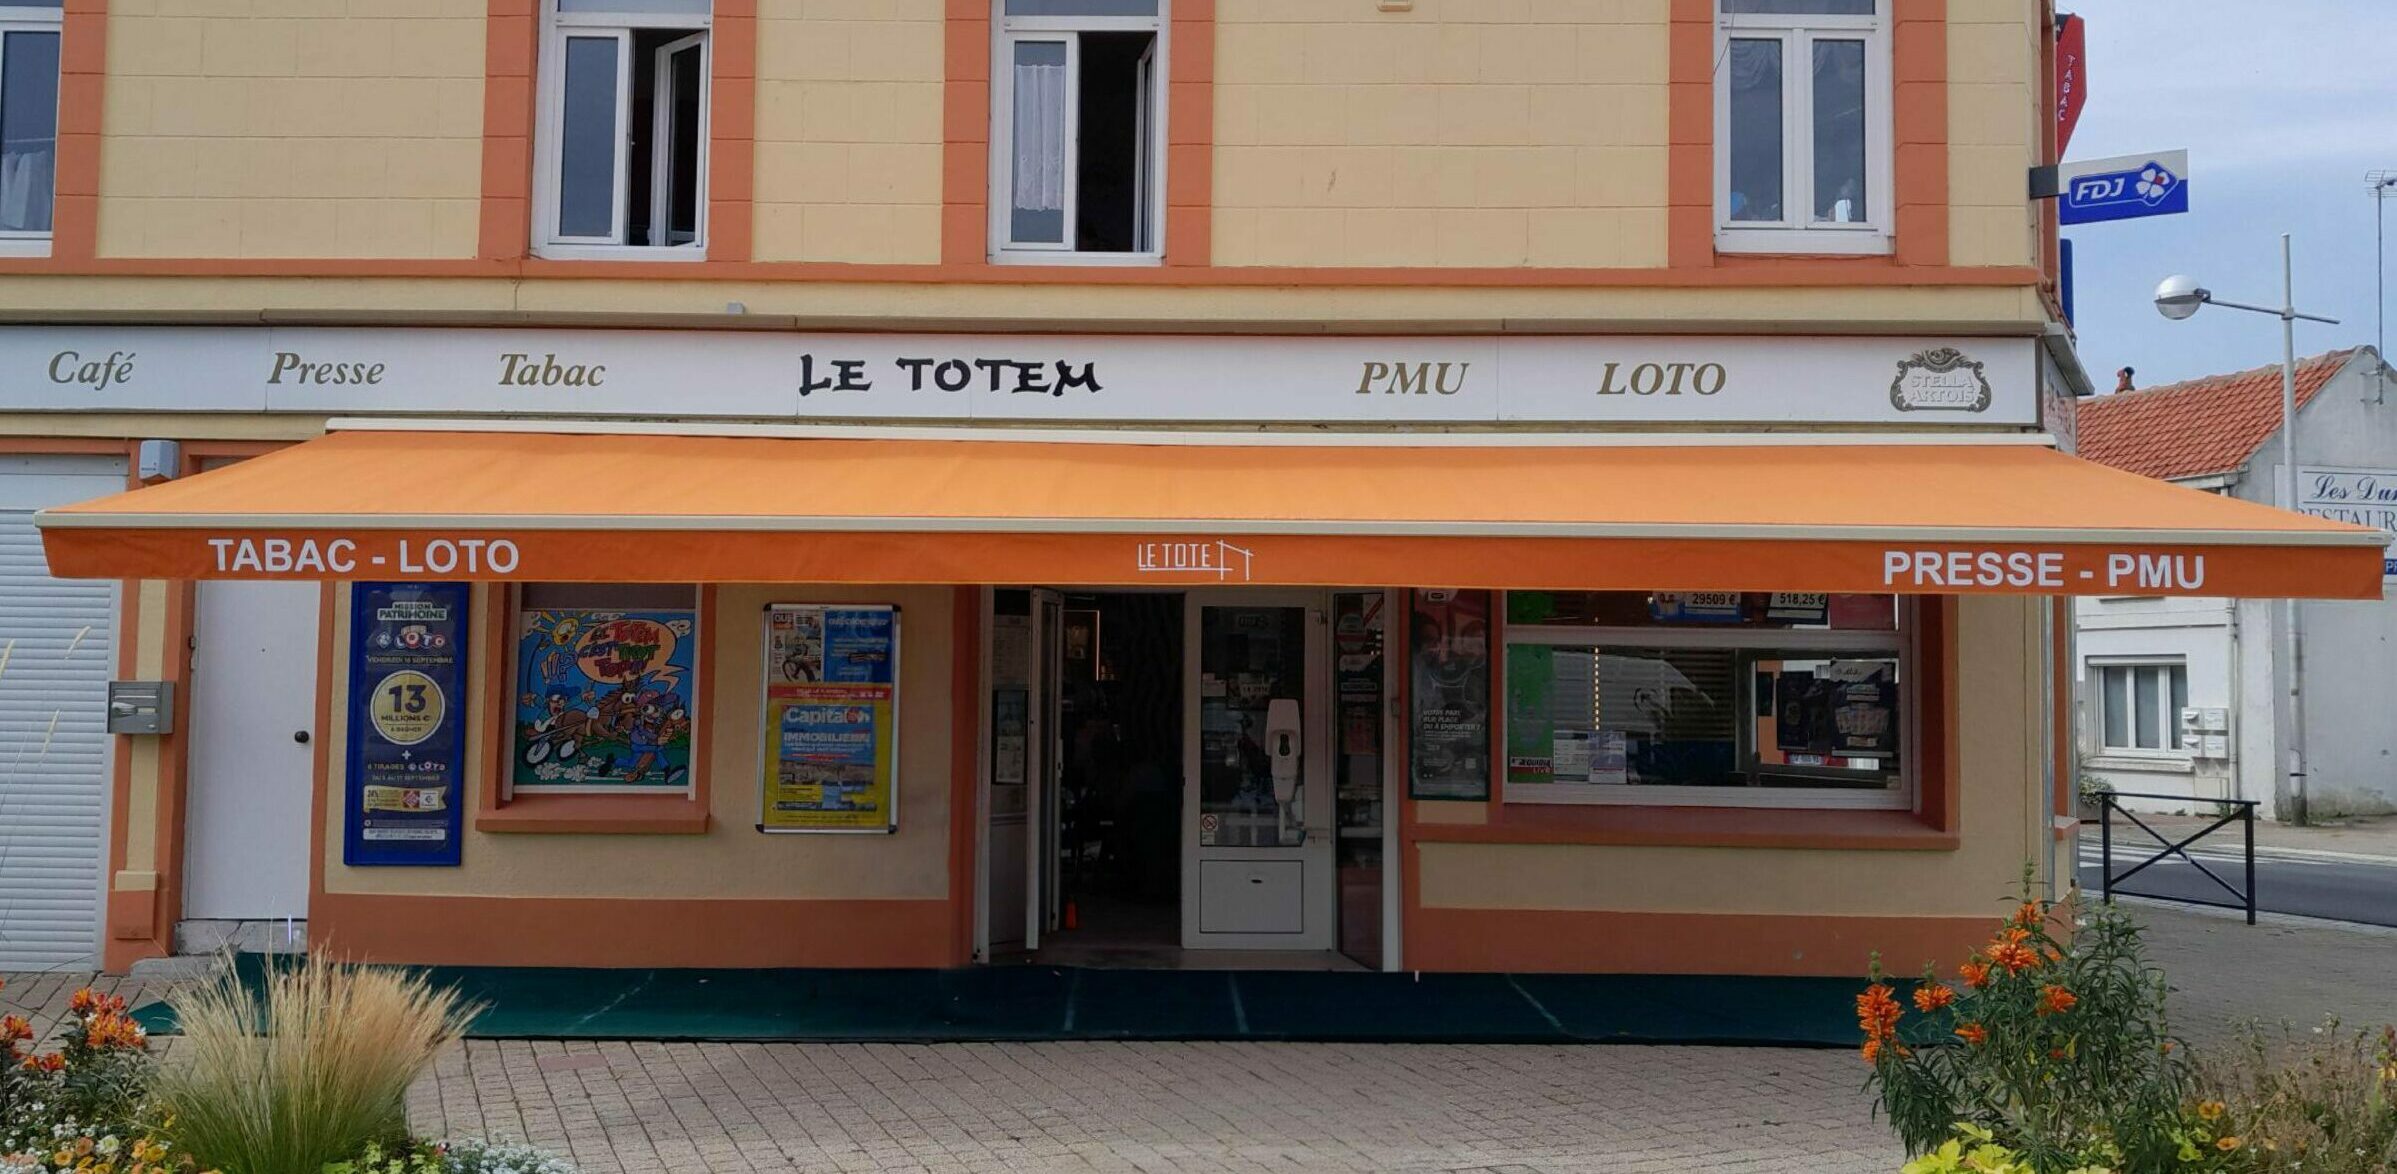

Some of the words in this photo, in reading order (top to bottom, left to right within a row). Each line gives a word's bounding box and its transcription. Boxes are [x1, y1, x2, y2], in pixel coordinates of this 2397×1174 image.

[2058, 54, 2076, 121] TABAC
[2076, 178, 2125, 201] FDJ
[48, 351, 135, 391] Café
[267, 351, 386, 385] Presse
[499, 352, 607, 387] Tabac
[799, 354, 872, 396] LE
[896, 357, 1104, 397] TOTEM
[1356, 361, 1470, 396] PMU
[1597, 361, 1728, 396] LOTO
[1911, 374, 1975, 388] STELLA
[1911, 388, 1975, 403] ARTOIS
[2311, 474, 2351, 500] Les
[2357, 476, 2397, 501] Du
[208, 537, 356, 573] TABAC
[399, 538, 519, 574] LOTO
[1883, 550, 2064, 587] PRESSE
[2107, 553, 2205, 589] PMU
[1692, 593, 1727, 606] 29509
[1779, 593, 1816, 605] 518,25
[379, 609, 445, 619] PATRIMOINE
[396, 631, 446, 648] LOTO
[388, 684, 427, 713] 13
[783, 707, 847, 725] Capital
